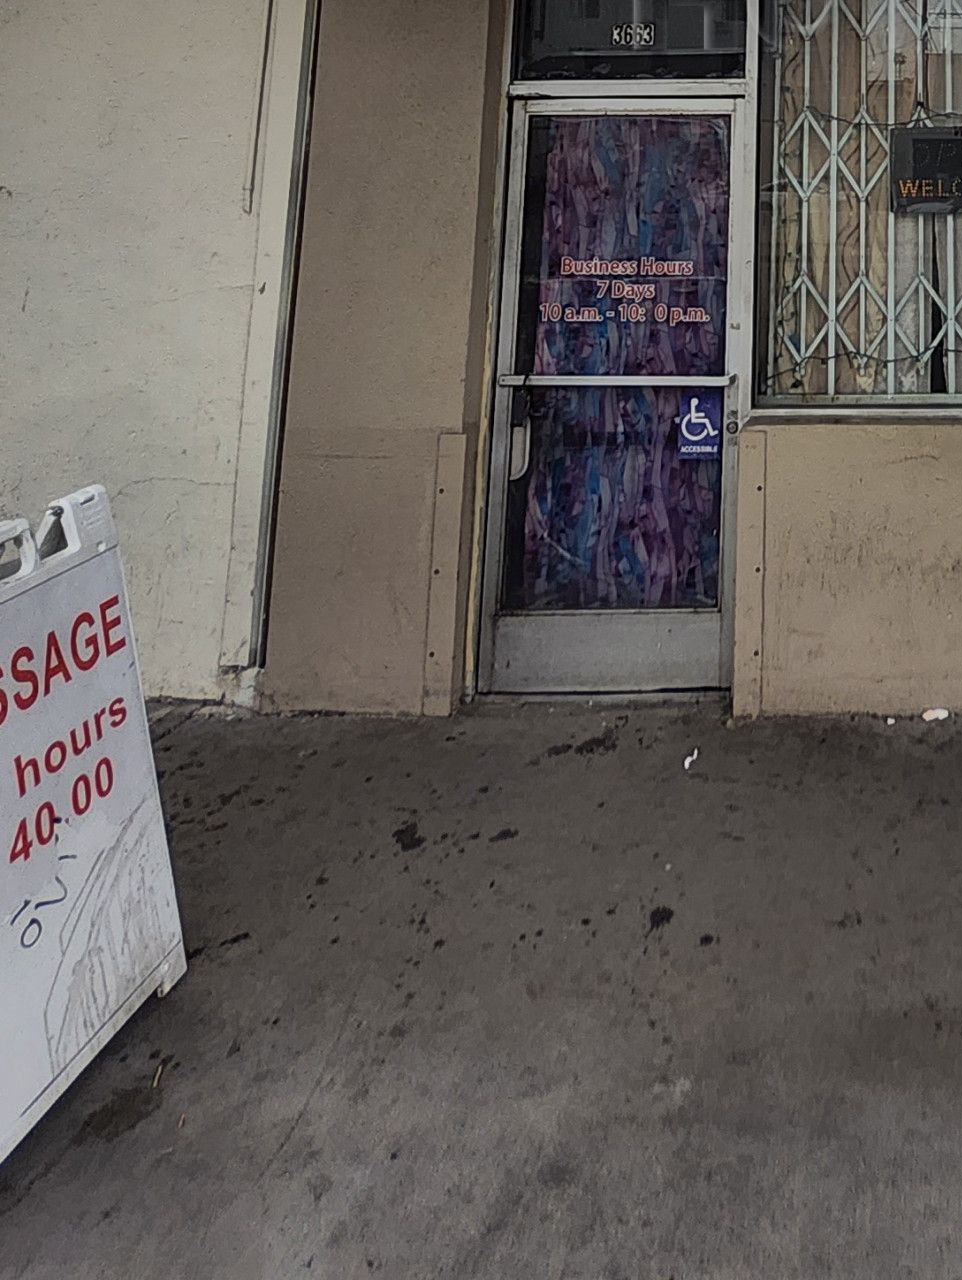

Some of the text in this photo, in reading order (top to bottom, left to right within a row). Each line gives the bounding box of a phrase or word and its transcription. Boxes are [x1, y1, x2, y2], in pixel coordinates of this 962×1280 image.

[612, 23, 654, 45] 3663
[561, 256, 693, 275] Business Hours
[597, 280, 655, 302] 7 Days
[539, 303, 562, 321] 10
[565, 306, 604, 321] a.m.
[670, 307, 710, 326] p.m.
[14, 696, 127, 798] hours
